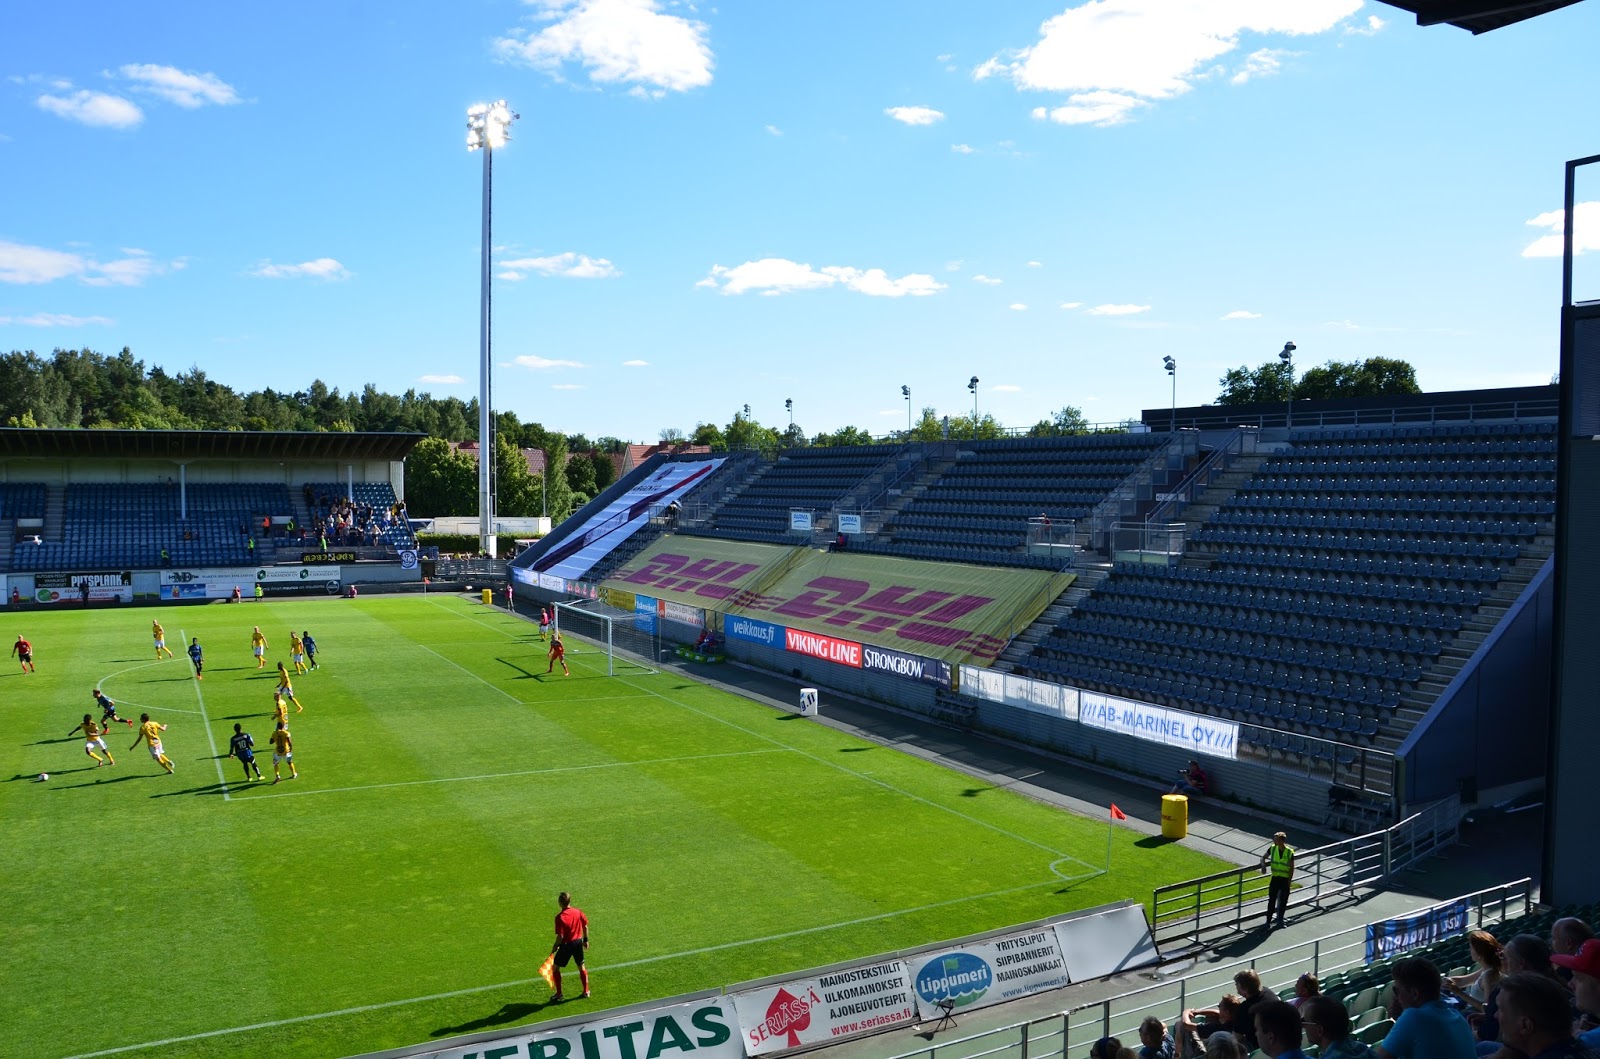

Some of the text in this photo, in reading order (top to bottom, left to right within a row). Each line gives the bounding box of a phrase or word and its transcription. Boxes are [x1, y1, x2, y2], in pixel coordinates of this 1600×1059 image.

[71, 574, 122, 587] PUTSPLANK
[733, 621, 775, 643] veikkaus.fi
[786, 632, 859, 665] VIKING LINE
[864, 648, 923, 678] STRONGBOW
[237, 740, 247, 749] 10
[995, 933, 1047, 952] YRITYSLIPUT
[995, 946, 1055, 967] SIIPIBANNERIT
[819, 962, 901, 988] MAINOSTEKSTIILIT
[920, 965, 988, 995] Lippumeri
[996, 959, 1063, 983] MAINOSKANKAAT
[824, 977, 904, 1004] ULKOMAINOKSET
[1002, 975, 1068, 998] www.lippumeri.fi
[749, 986, 822, 1047] SERIÄSSÄ
[830, 993, 907, 1019] AJONEUVOTEIPIT
[831, 1008, 912, 1036] www.seriassa.fi
